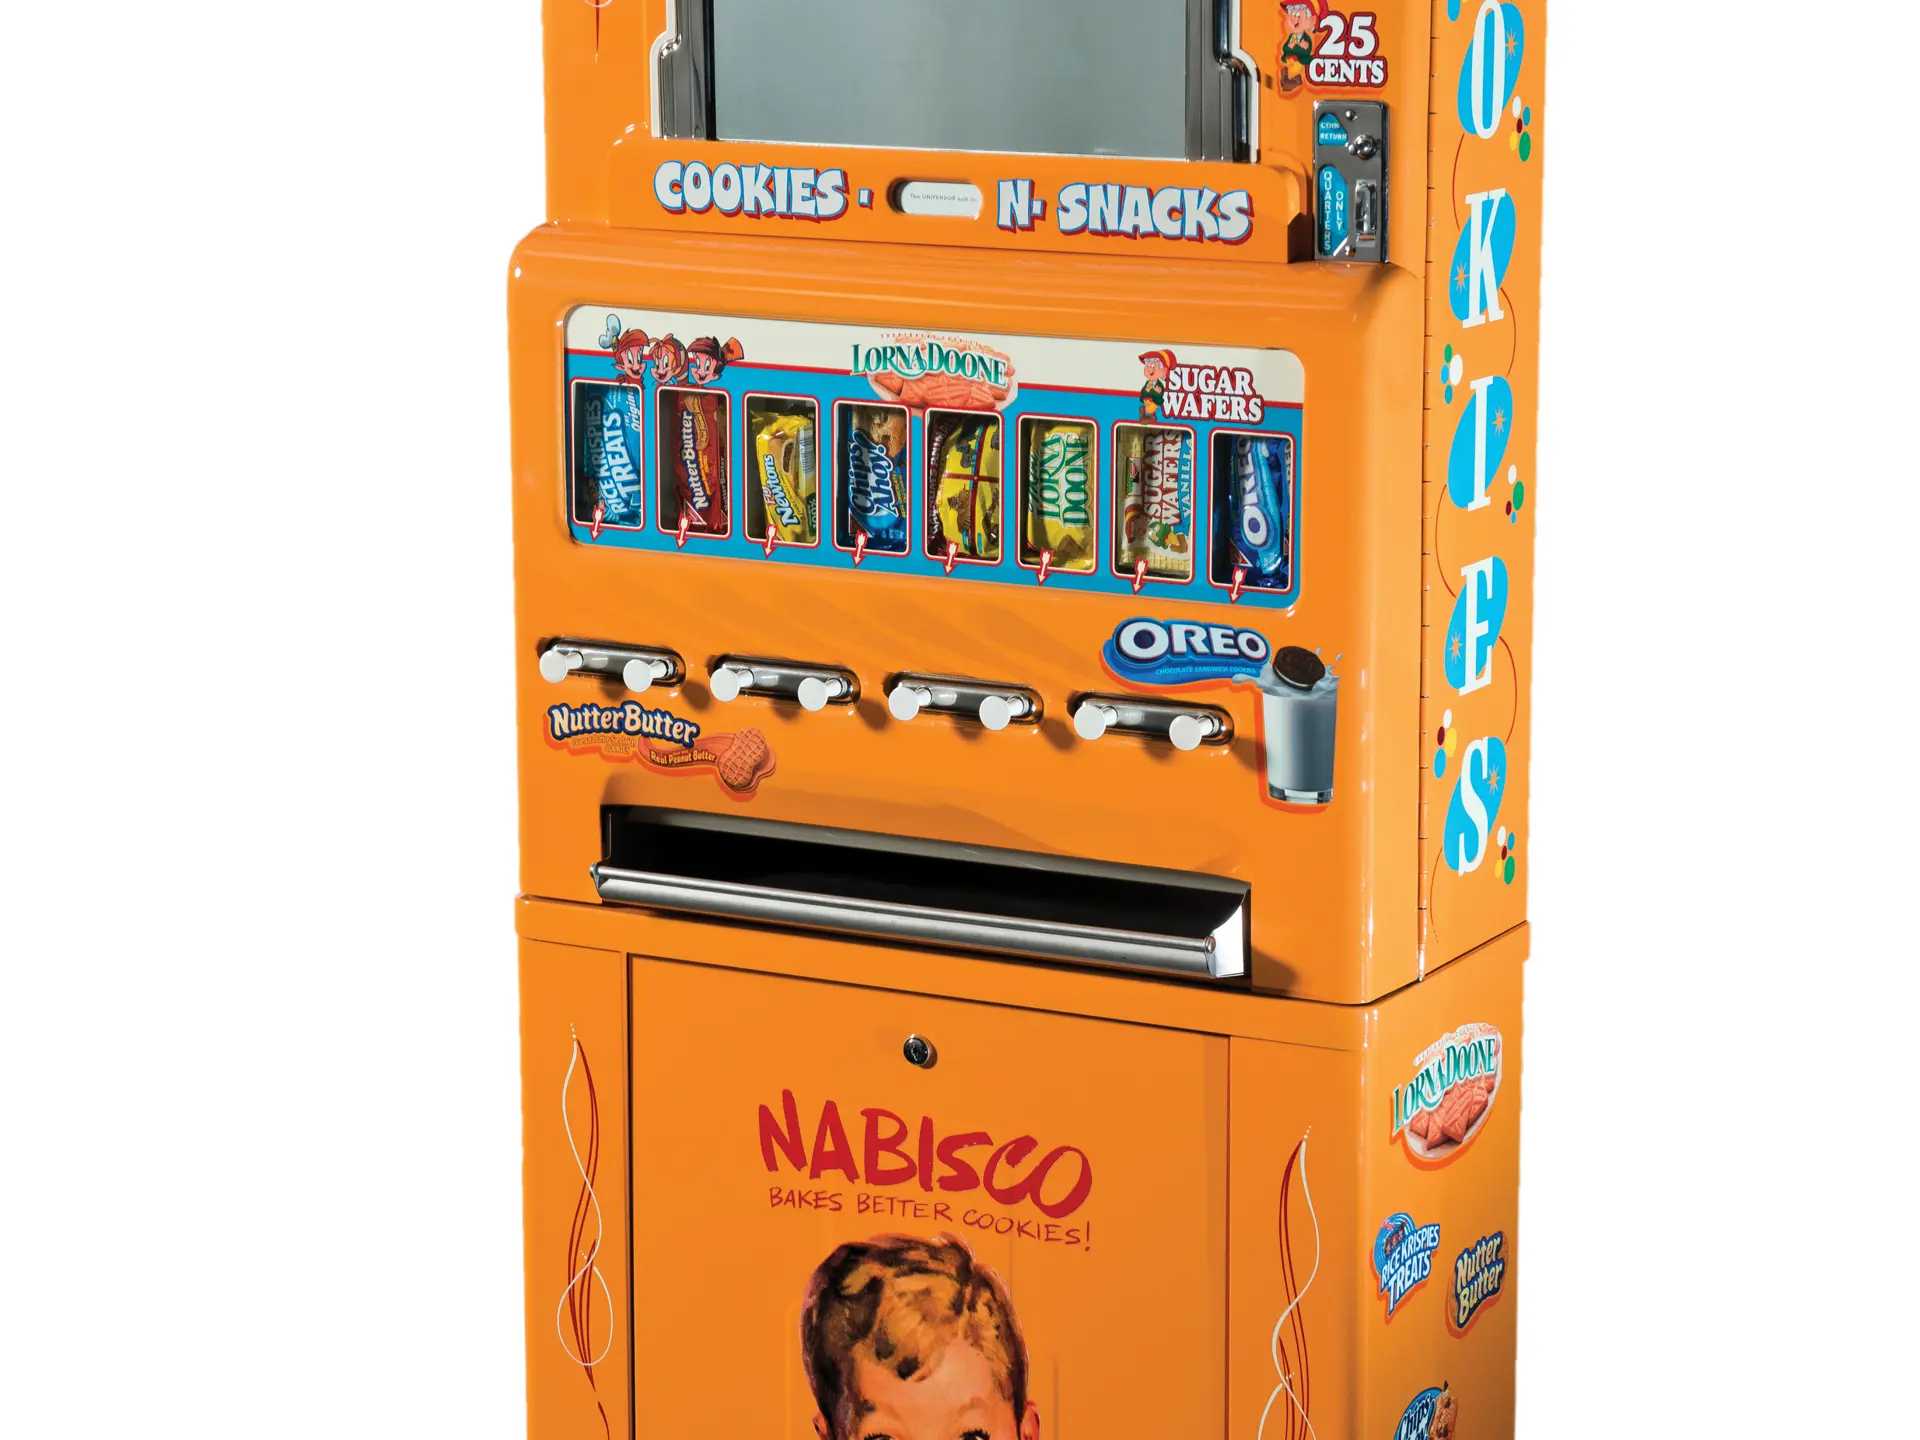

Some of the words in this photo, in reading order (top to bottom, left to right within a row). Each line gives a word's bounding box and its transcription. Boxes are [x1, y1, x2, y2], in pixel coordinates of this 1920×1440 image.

[1319, 14, 1376, 57] 25
[1309, 58, 1385, 84] CENTS
[654, 160, 846, 217] COOKIES
[1057, 183, 1250, 239] SNACKS
[1323, 170, 1333, 251] QUARTERS
[1335, 191, 1344, 231] ONLY
[852, 343, 927, 377] LORNA
[926, 342, 1007, 387] DOONE
[1167, 368, 1253, 395] SUGAR
[586, 398, 610, 479] KRISPIES
[682, 410, 697, 461] Butter
[1162, 394, 1263, 422] WAFERS
[603, 411, 640, 498] TREATS
[687, 460, 710, 509] Nutter
[848, 442, 877, 516] Chips
[853, 430, 899, 517] Ahoy!
[1038, 435, 1066, 518] LORNA
[1063, 433, 1090, 525] DOONE
[1144, 434, 1162, 517] SUGAR
[1162, 429, 1181, 525] WAFERS
[1181, 438, 1192, 518] VANILLA
[599, 479, 628, 514] RICE
[764, 455, 799, 526] Newtons
[1237, 436, 1268, 546] OREO
[1118, 621, 1267, 661] OREO
[1155, 665, 1194, 676] CHOCOLATE
[1194, 666, 1228, 674] SANDWICH
[1229, 665, 1257, 675] COOKIES
[551, 707, 625, 737] Nutter
[624, 704, 699, 743] Butter
[650, 752, 667, 765] Real
[668, 752, 692, 765] Peanut
[693, 750, 716, 763] Butter
[1393, 1058, 1446, 1132] LORNA
[1446, 1038, 1496, 1084] DOONE
[758, 1088, 1093, 1219] NABISCO
[769, 1186, 843, 1212] BAKES
[856, 1192, 953, 1222] BETTER
[962, 1208, 1092, 1252] COOKIES!
[1381, 1250, 1401, 1289] RICE
[1400, 1225, 1440, 1262] KRISPIES
[1388, 1250, 1431, 1315] TREATS
[1457, 1235, 1503, 1294] Nutter
[1458, 1262, 1503, 1324] Butter
